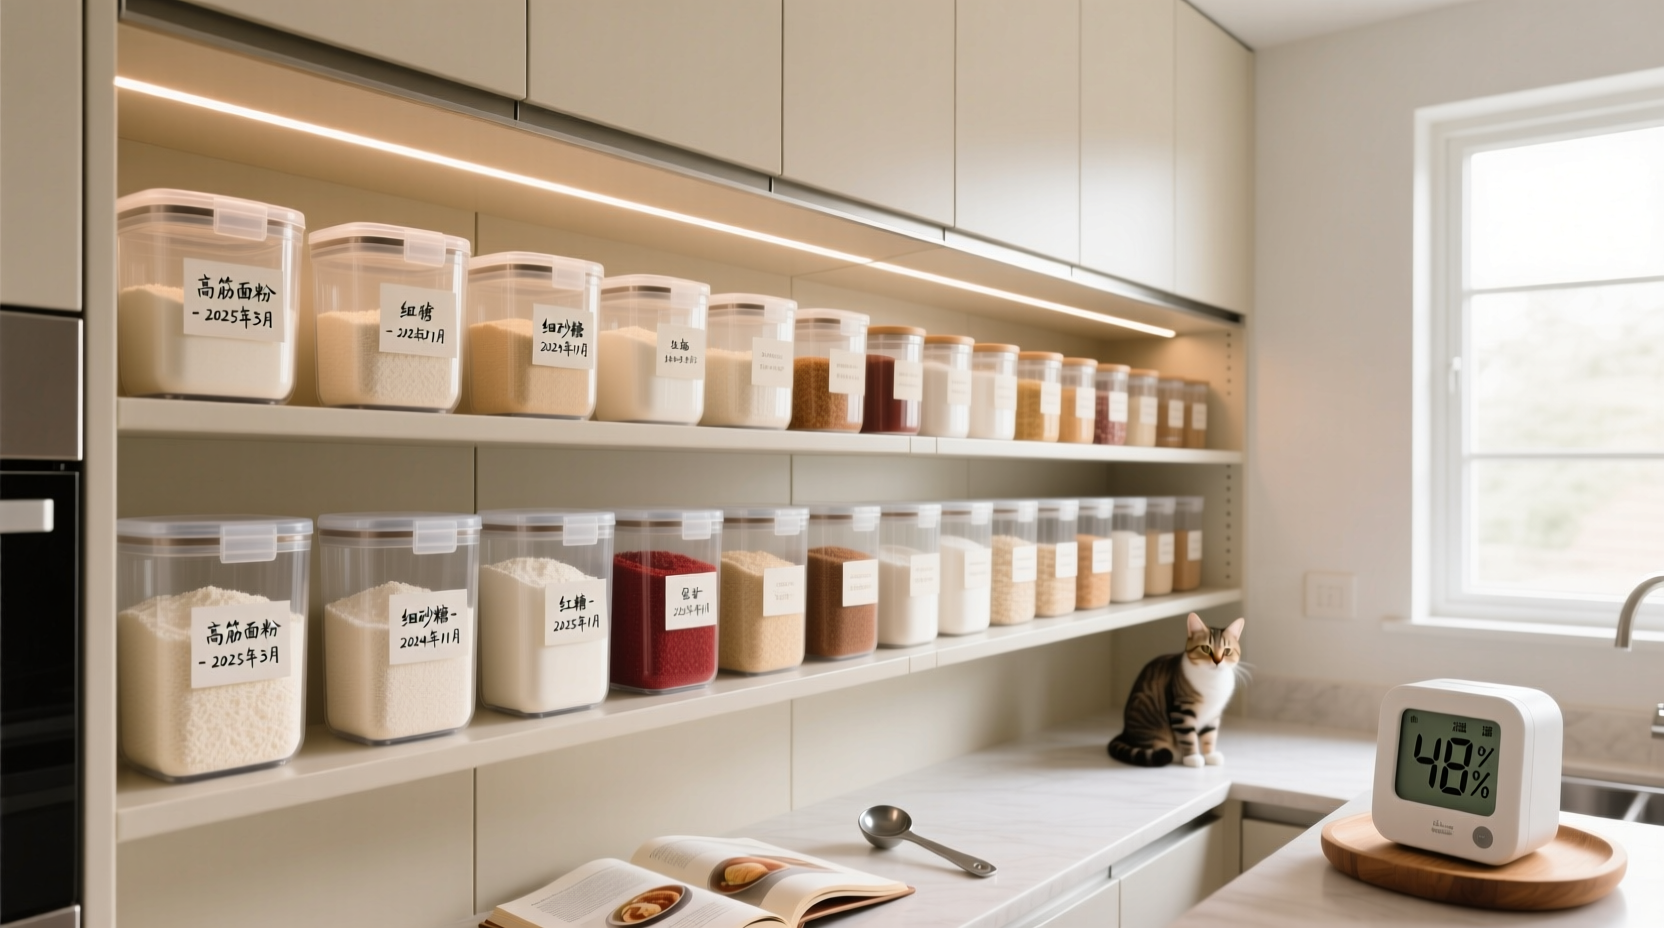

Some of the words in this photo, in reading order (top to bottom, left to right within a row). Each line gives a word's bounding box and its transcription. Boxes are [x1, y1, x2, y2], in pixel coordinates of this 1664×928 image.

[197, 273, 277, 303] 高筋面粉
[206, 618, 282, 646] 高筋面粉
[553, 613, 600, 633] 2025年1月
[399, 628, 460, 649] 2024年11月
